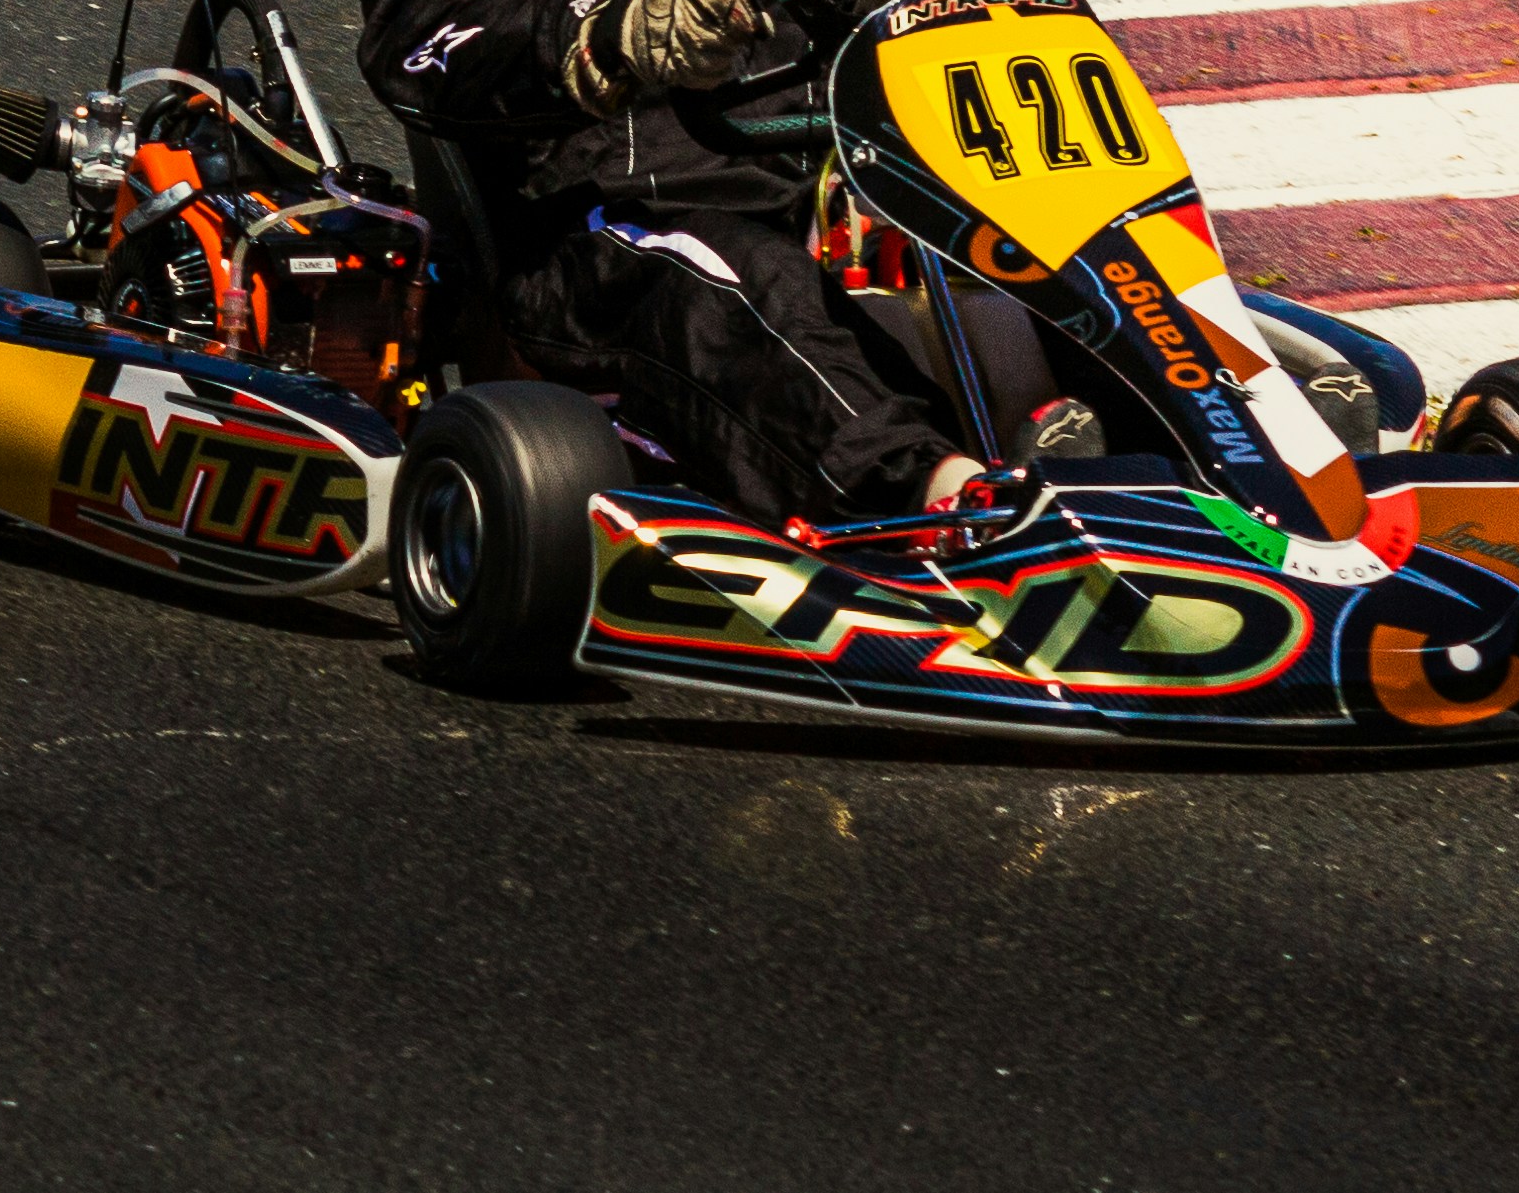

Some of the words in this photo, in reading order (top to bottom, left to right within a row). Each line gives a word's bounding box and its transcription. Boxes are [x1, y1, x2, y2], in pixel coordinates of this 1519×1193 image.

[944, 52, 1150, 181] 420
[55, 402, 368, 544] INTR
[598, 528, 1295, 680] EPID
